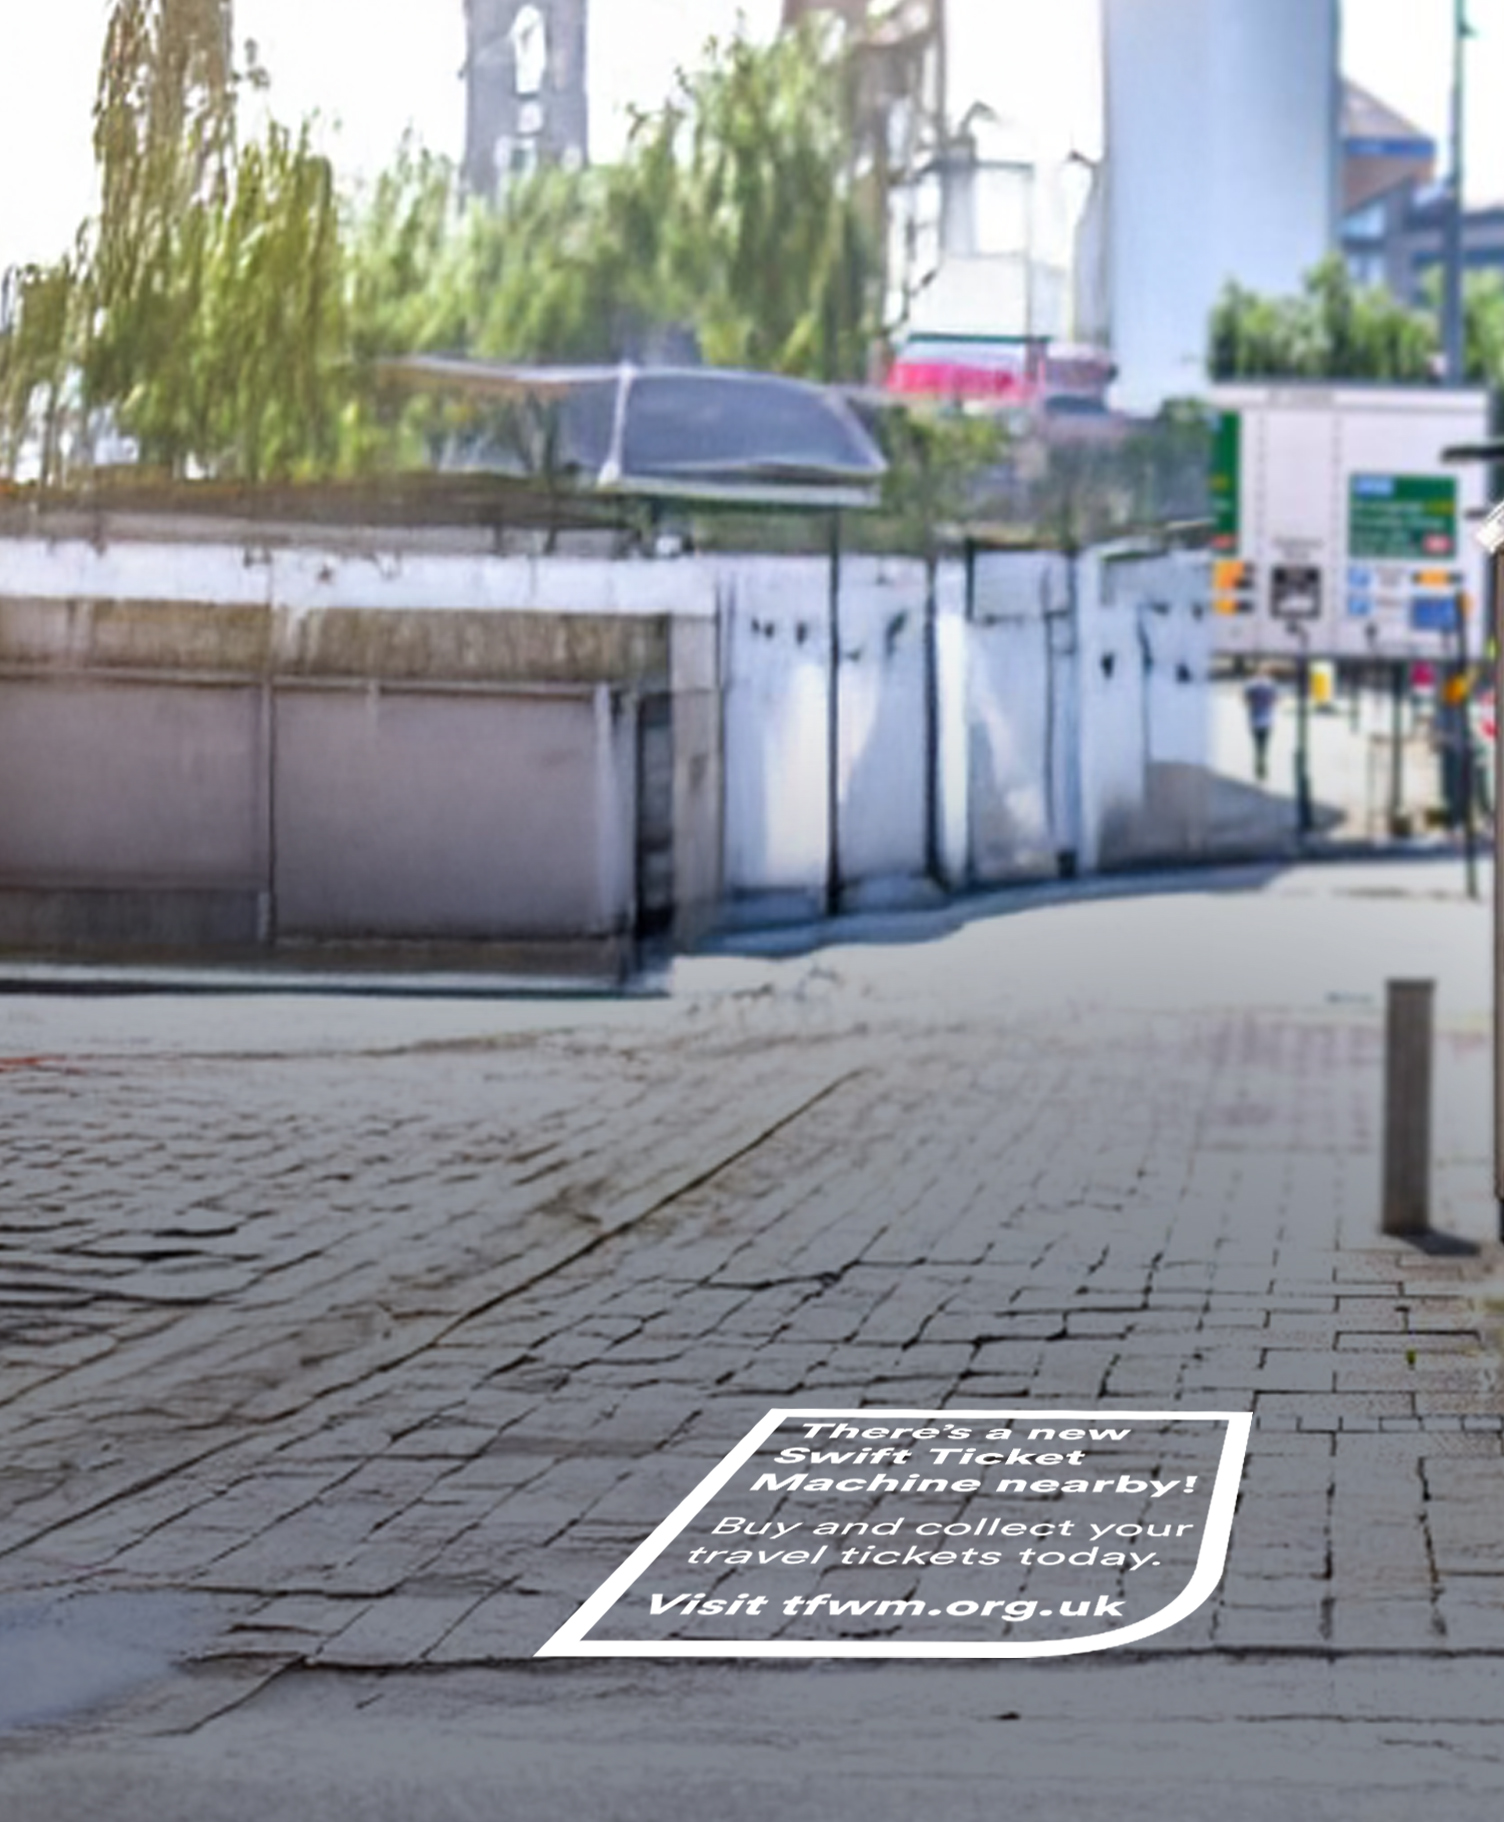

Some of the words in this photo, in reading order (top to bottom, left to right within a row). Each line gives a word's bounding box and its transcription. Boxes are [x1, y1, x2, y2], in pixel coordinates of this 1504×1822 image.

[801, 1423, 972, 1440] There’s
[984, 1427, 1013, 1440] a
[1027, 1428, 1131, 1441] new
[773, 1447, 913, 1465] Swift
[929, 1448, 1085, 1466] Ticket
[749, 1473, 981, 1492] Machine
[995, 1475, 1198, 1498] nearby!
[711, 1516, 803, 1540] Buy
[812, 1517, 905, 1536] and
[914, 1517, 1076, 1536] collect
[1088, 1523, 1195, 1541] your
[687, 1545, 828, 1565] travel
[840, 1545, 1003, 1566] tickets
[1018, 1546, 1161, 1571] today.
[649, 1592, 769, 1616] Visit
[781, 1593, 1126, 1622] tfwm.org.uk
